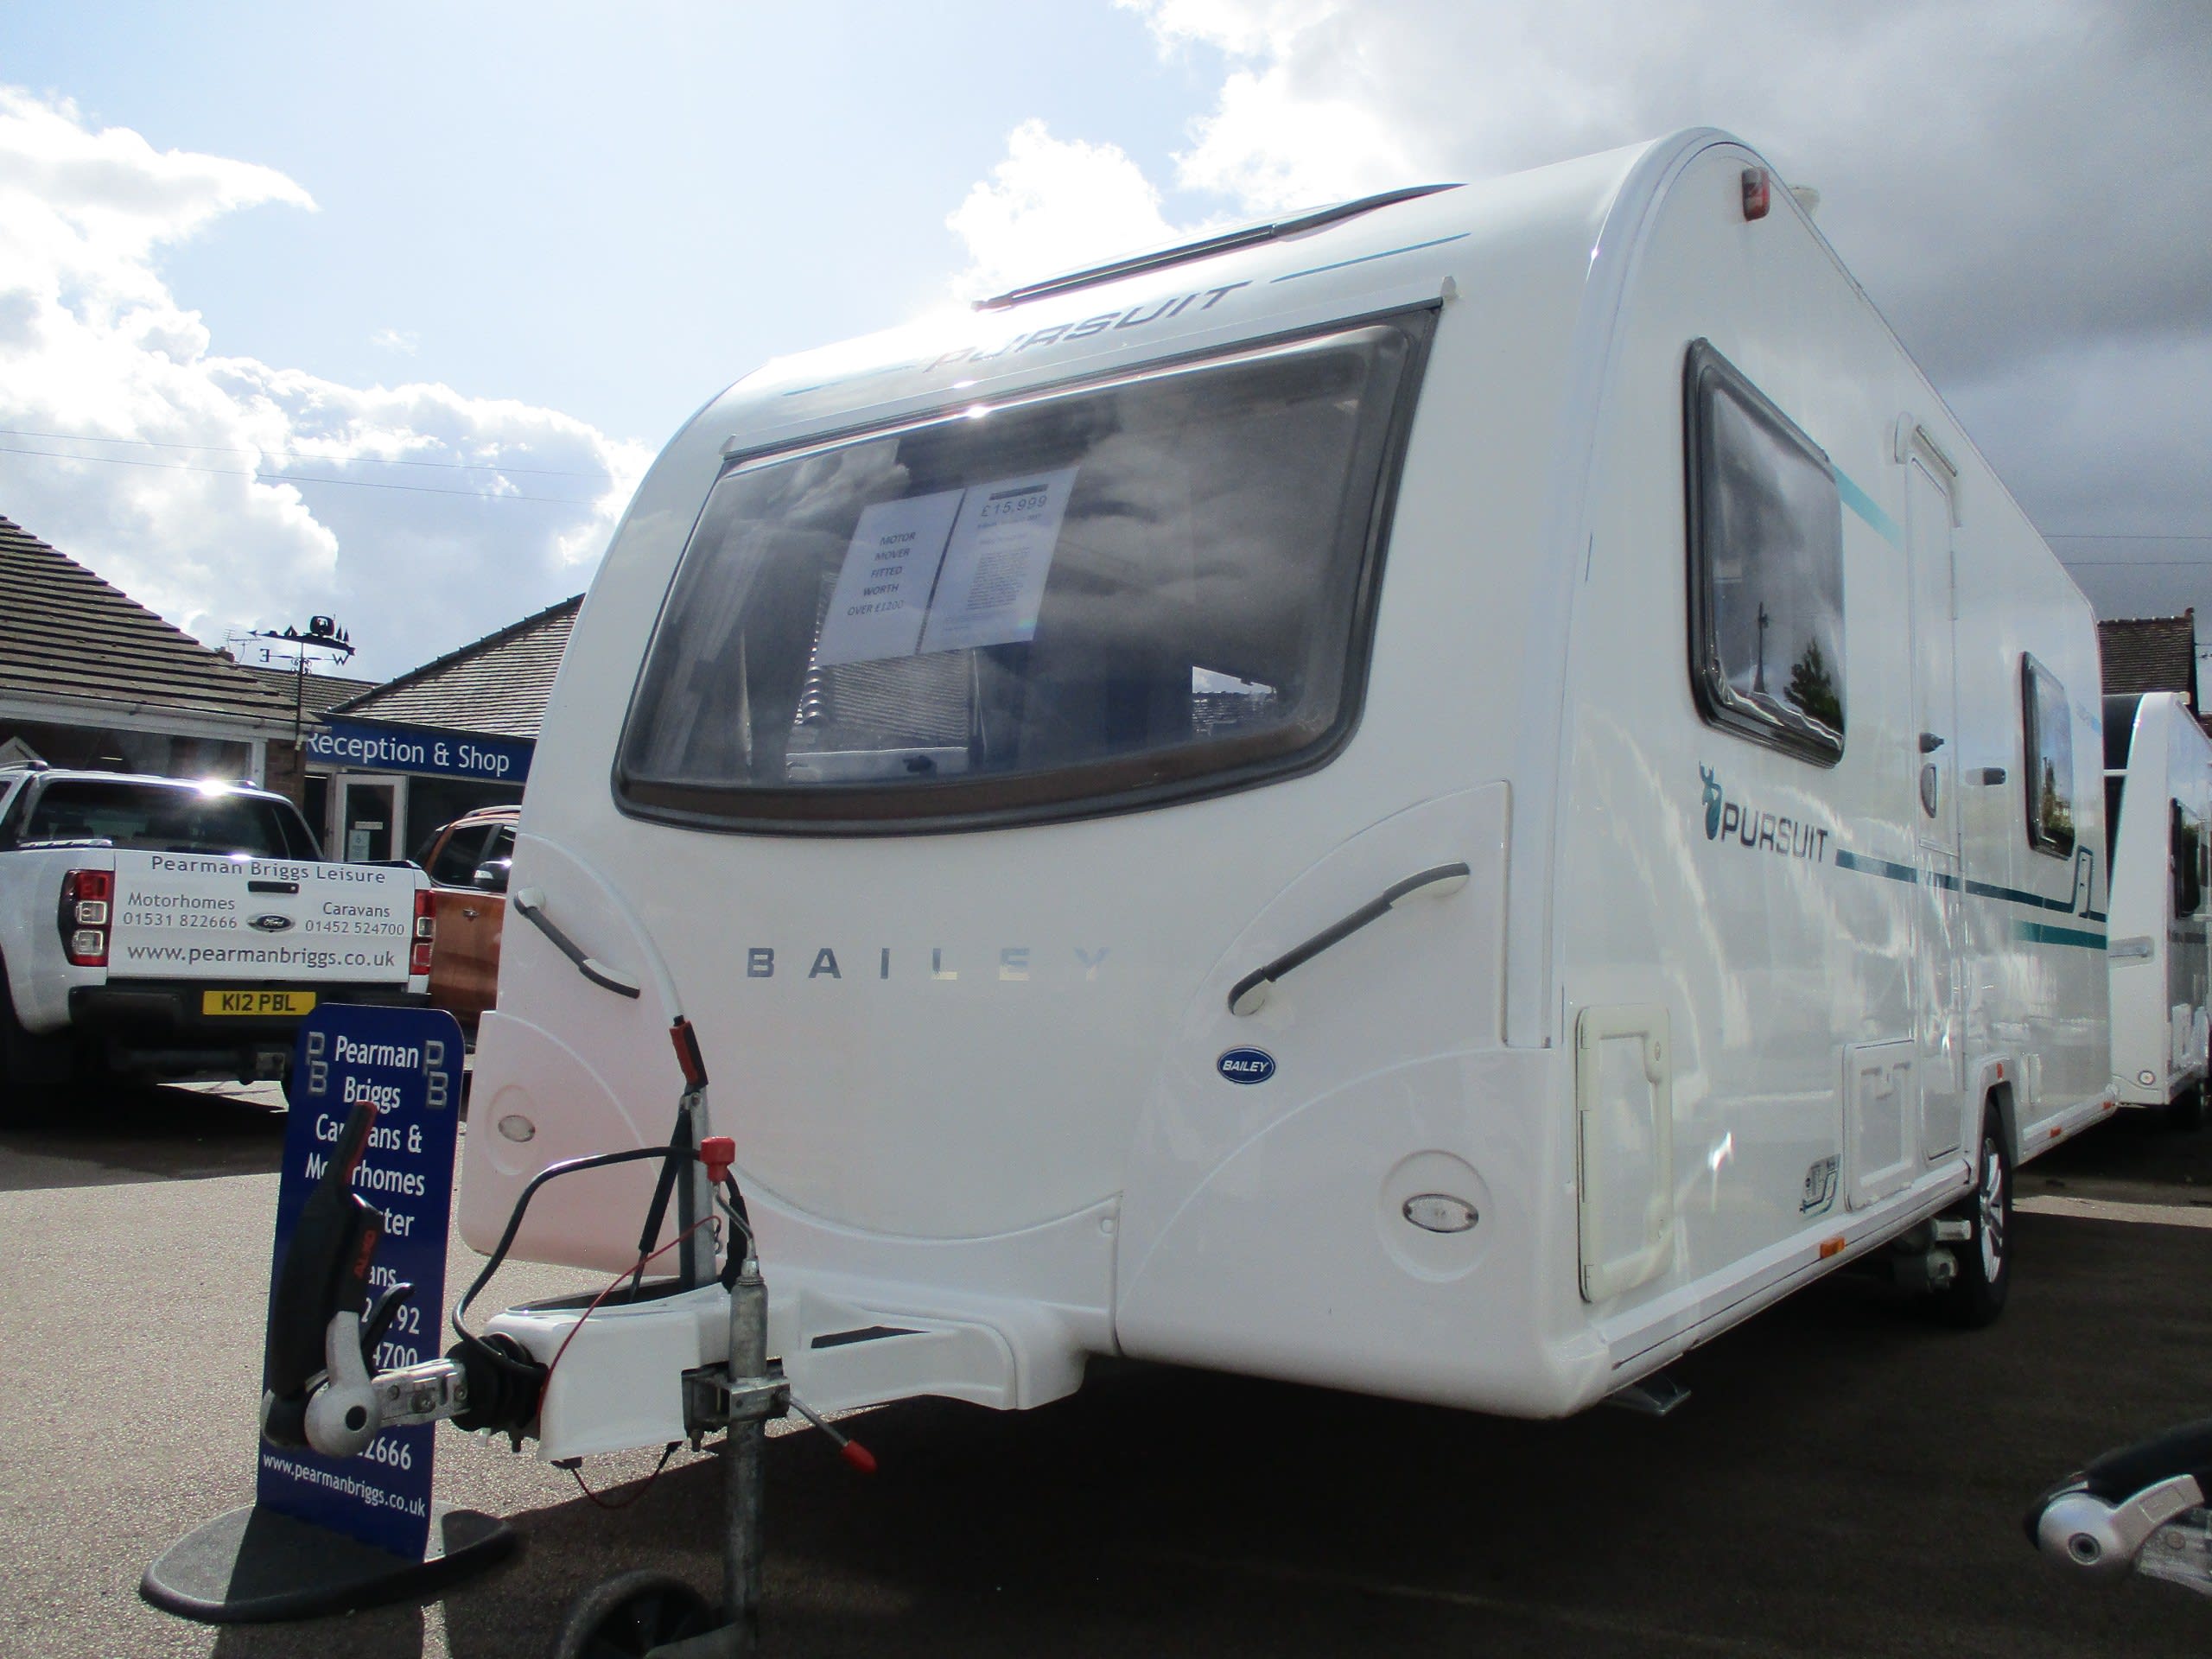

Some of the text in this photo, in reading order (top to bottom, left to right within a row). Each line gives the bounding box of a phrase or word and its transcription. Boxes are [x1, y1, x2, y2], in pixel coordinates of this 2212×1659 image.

[922, 281, 1253, 374] PURSUIT
[880, 531, 916, 546] MOTOR
[874, 548, 911, 561] MOVER
[870, 566, 903, 578] FITTED
[864, 584, 899, 596] WORTH
[847, 604, 874, 616] OVER
[434, 742, 449, 766] &
[458, 745, 510, 777] Shop
[1720, 802, 1828, 862] PURSUIT
[152, 855, 386, 884] Pearman Briggs Leisure
[128, 892, 235, 910] Motorhomes
[322, 901, 391, 918] Caravans
[124, 912, 238, 929] 01531 822666
[305, 919, 404, 936] 01452 524700
[128, 946, 395, 968] www.pearmanbriggs.co.uk
[747, 947, 1109, 982] BAILEY
[222, 994, 296, 1011] K12 PBL
[334, 1035, 418, 1069] Pearman
[1223, 1060, 1269, 1072] BAILEY
[343, 1076, 402, 1115] Briggs
[315, 1113, 423, 1153] Caans &
[263, 1454, 426, 1517] www.pearmanbriggs.co.uk
